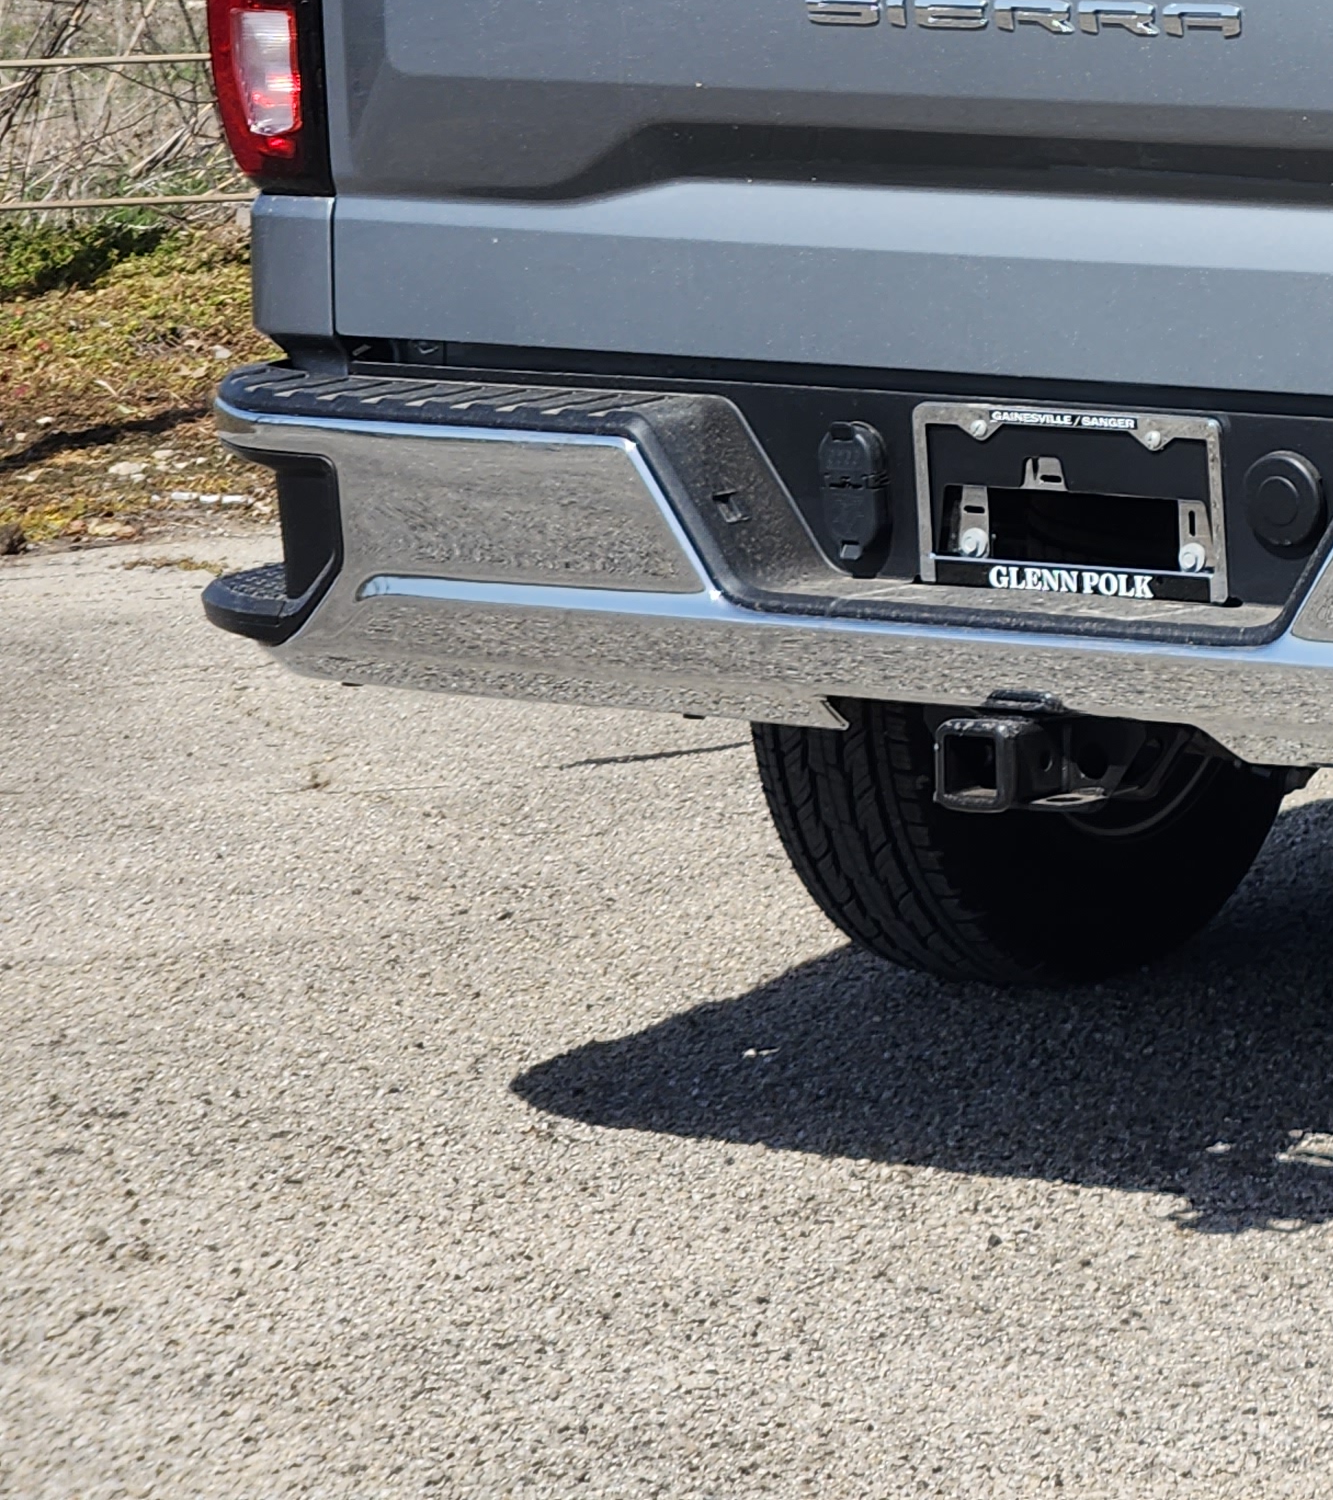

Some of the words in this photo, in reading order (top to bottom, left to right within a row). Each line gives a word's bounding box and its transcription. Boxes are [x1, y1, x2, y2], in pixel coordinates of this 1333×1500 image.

[991, 411, 1073, 425] GAINESVILLE
[1073, 415, 1081, 428] /
[1081, 416, 1135, 429] SANGER
[989, 565, 1079, 592] GLENN
[1082, 571, 1153, 598] POLK
